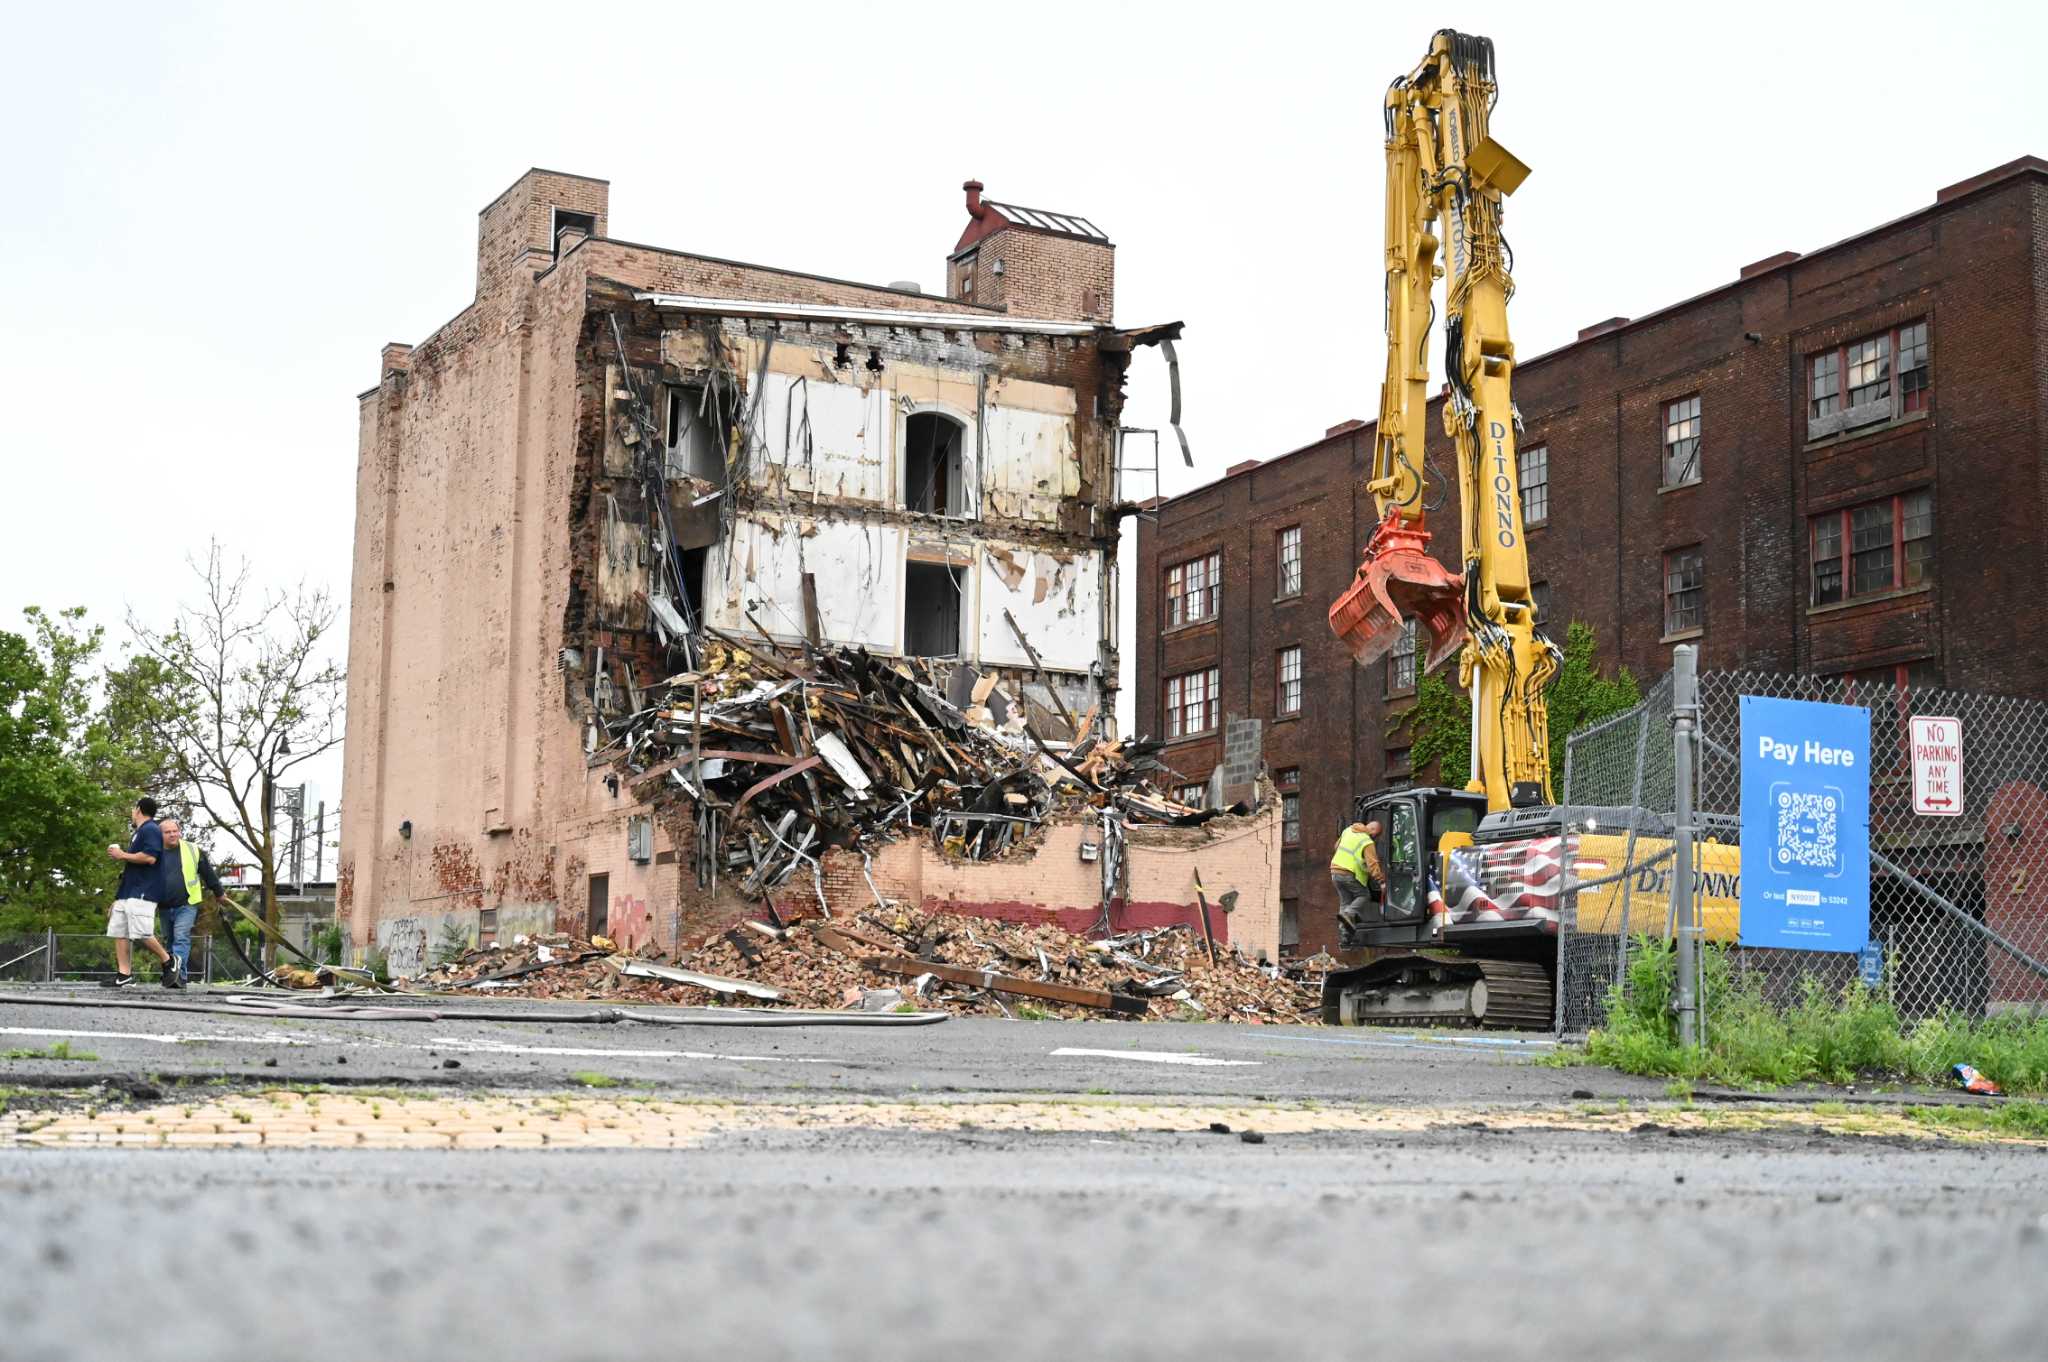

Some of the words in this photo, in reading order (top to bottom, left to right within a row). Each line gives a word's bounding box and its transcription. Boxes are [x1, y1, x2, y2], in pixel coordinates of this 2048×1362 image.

[1927, 726, 1945, 742] NO
[1759, 736, 1799, 766] Pay
[1804, 740, 1855, 767] Here
[1916, 744, 1957, 762] PARKING
[1928, 765, 1948, 778] ANY
[1927, 780, 1949, 794] TIME
